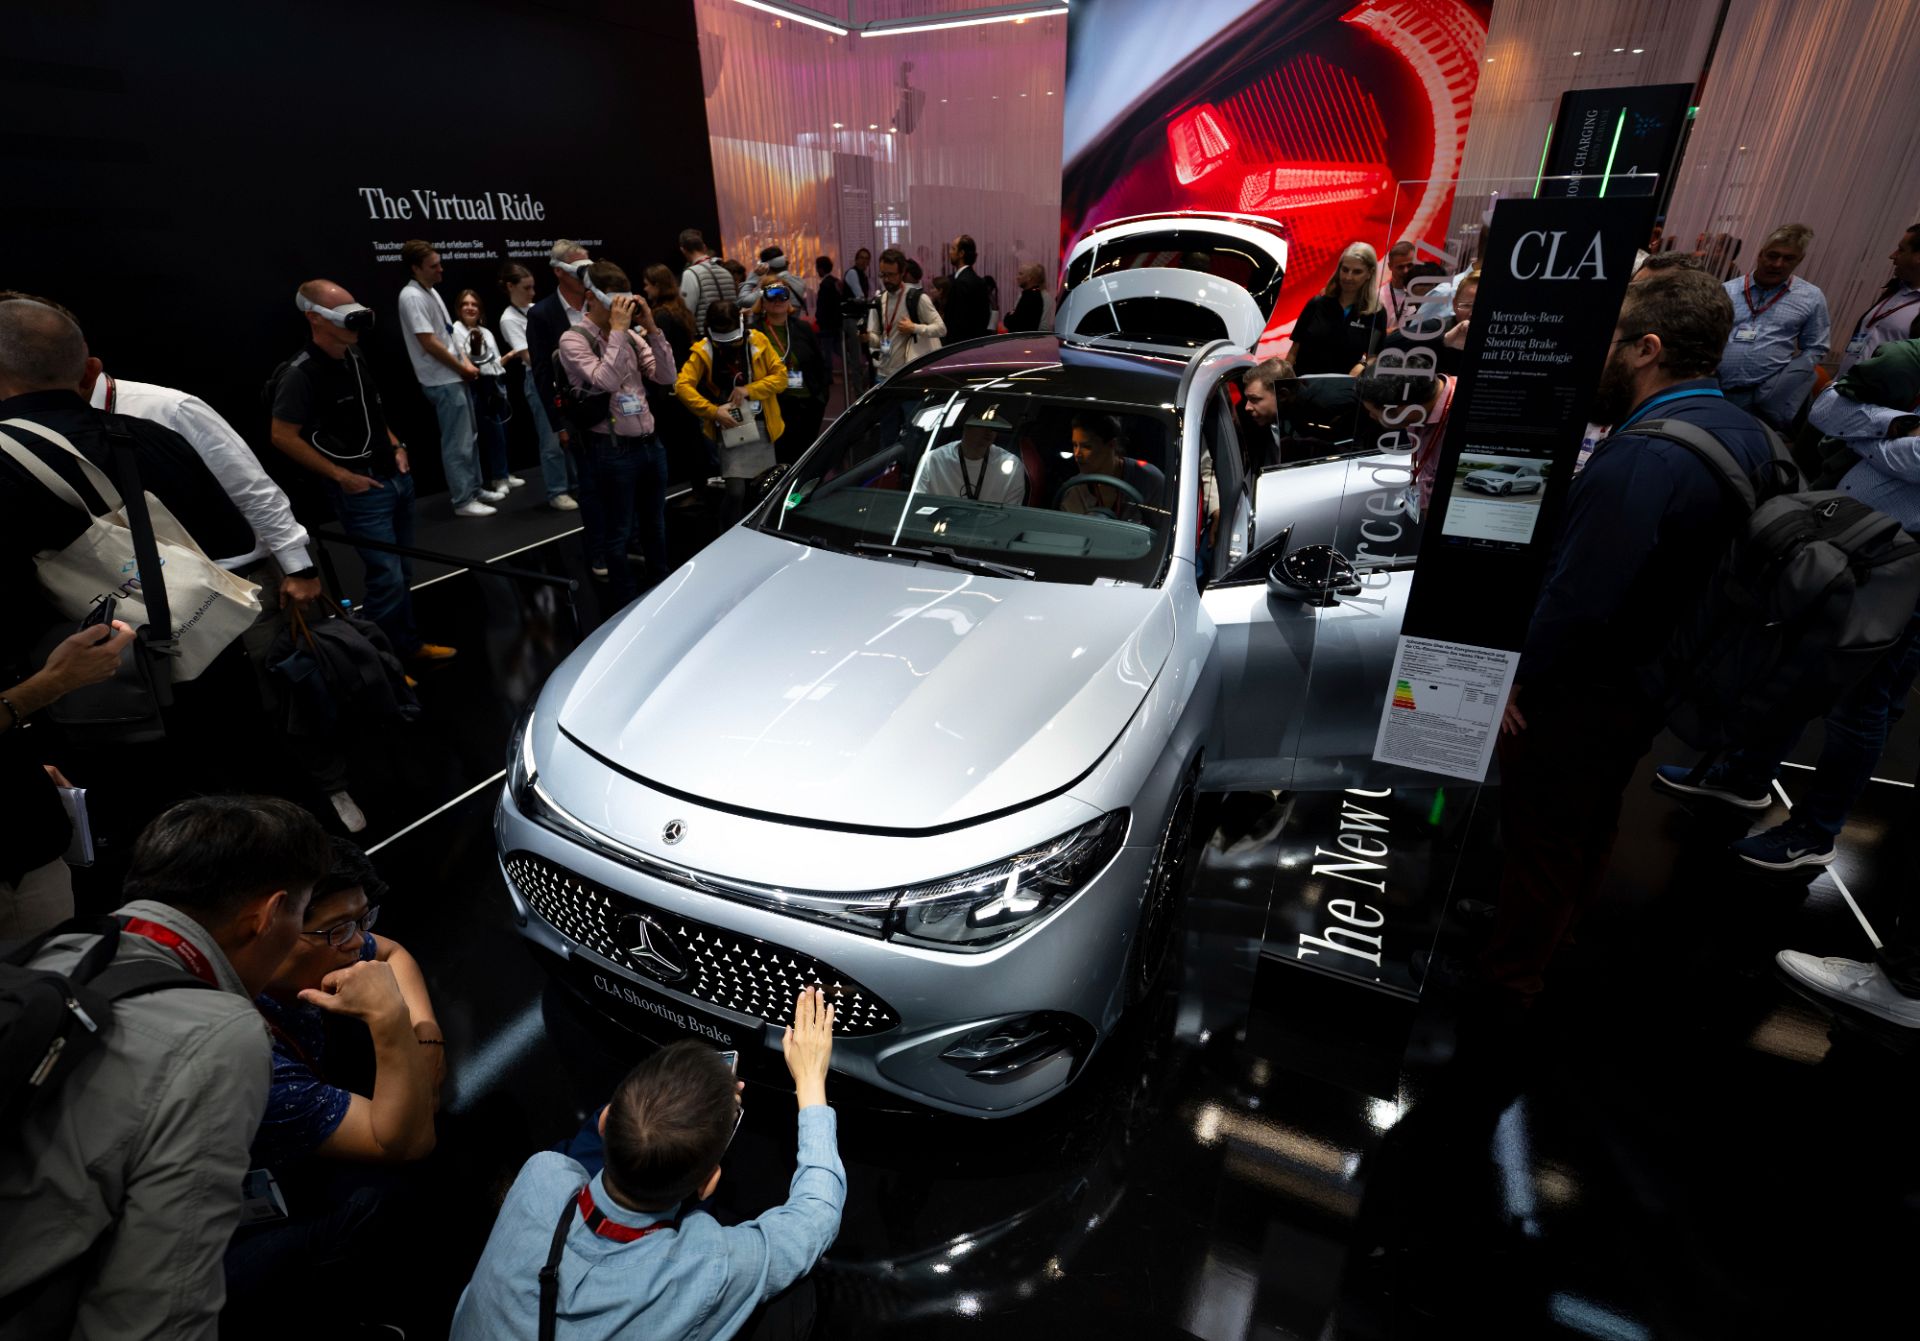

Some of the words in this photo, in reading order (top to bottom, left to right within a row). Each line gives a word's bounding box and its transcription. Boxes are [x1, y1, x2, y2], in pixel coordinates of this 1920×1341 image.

[1574, 108, 1598, 167] CHARGING
[359, 187, 412, 220] The
[412, 189, 496, 221] Virtual
[497, 192, 546, 221] Ride
[473, 240, 484, 248] Sie
[505, 239, 520, 247] Take
[526, 239, 541, 247] deep
[376, 254, 403, 262] unsere
[442, 251, 453, 260] auf
[1510, 230, 1608, 280] CLA
[1491, 310, 1564, 324] Mercedes-Benz
[1488, 324, 1508, 335] CLA
[1510, 324, 1534, 335] 250+
[1484, 337, 1527, 350] Shooting
[1528, 338, 1558, 349] Brake
[1481, 350, 1499, 360] mit
[1499, 350, 1515, 363] EQ
[1516, 350, 1573, 364] Technologie
[1326, 238, 1462, 637] Mercedes-Benz
[1311, 800, 1390, 893] New
[593, 974, 622, 999] CLA
[623, 989, 686, 1029] Shooting
[688, 1015, 733, 1046] Brake
